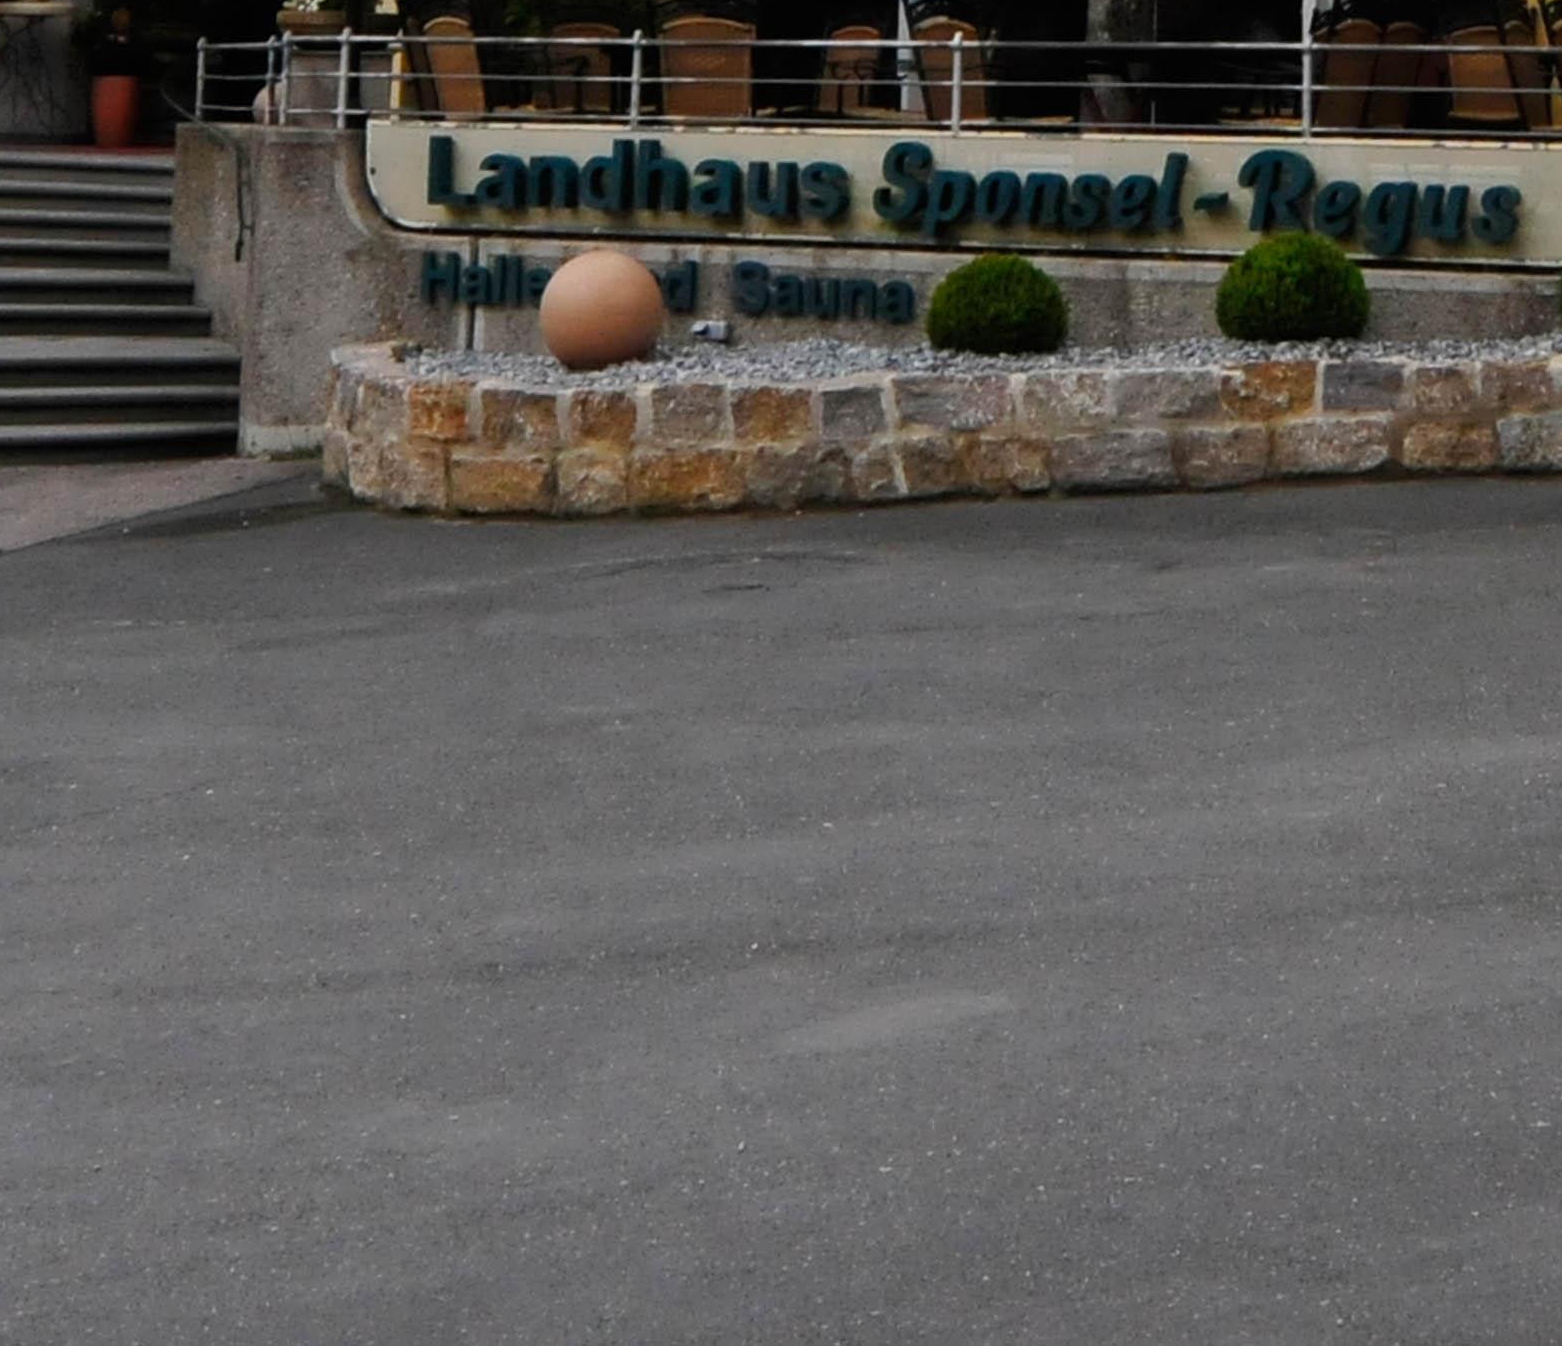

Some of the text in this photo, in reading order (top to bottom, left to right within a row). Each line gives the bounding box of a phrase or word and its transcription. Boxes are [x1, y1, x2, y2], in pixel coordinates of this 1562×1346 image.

[427, 134, 852, 221] Landhaus
[420, 249, 918, 327] Halled Sauna
